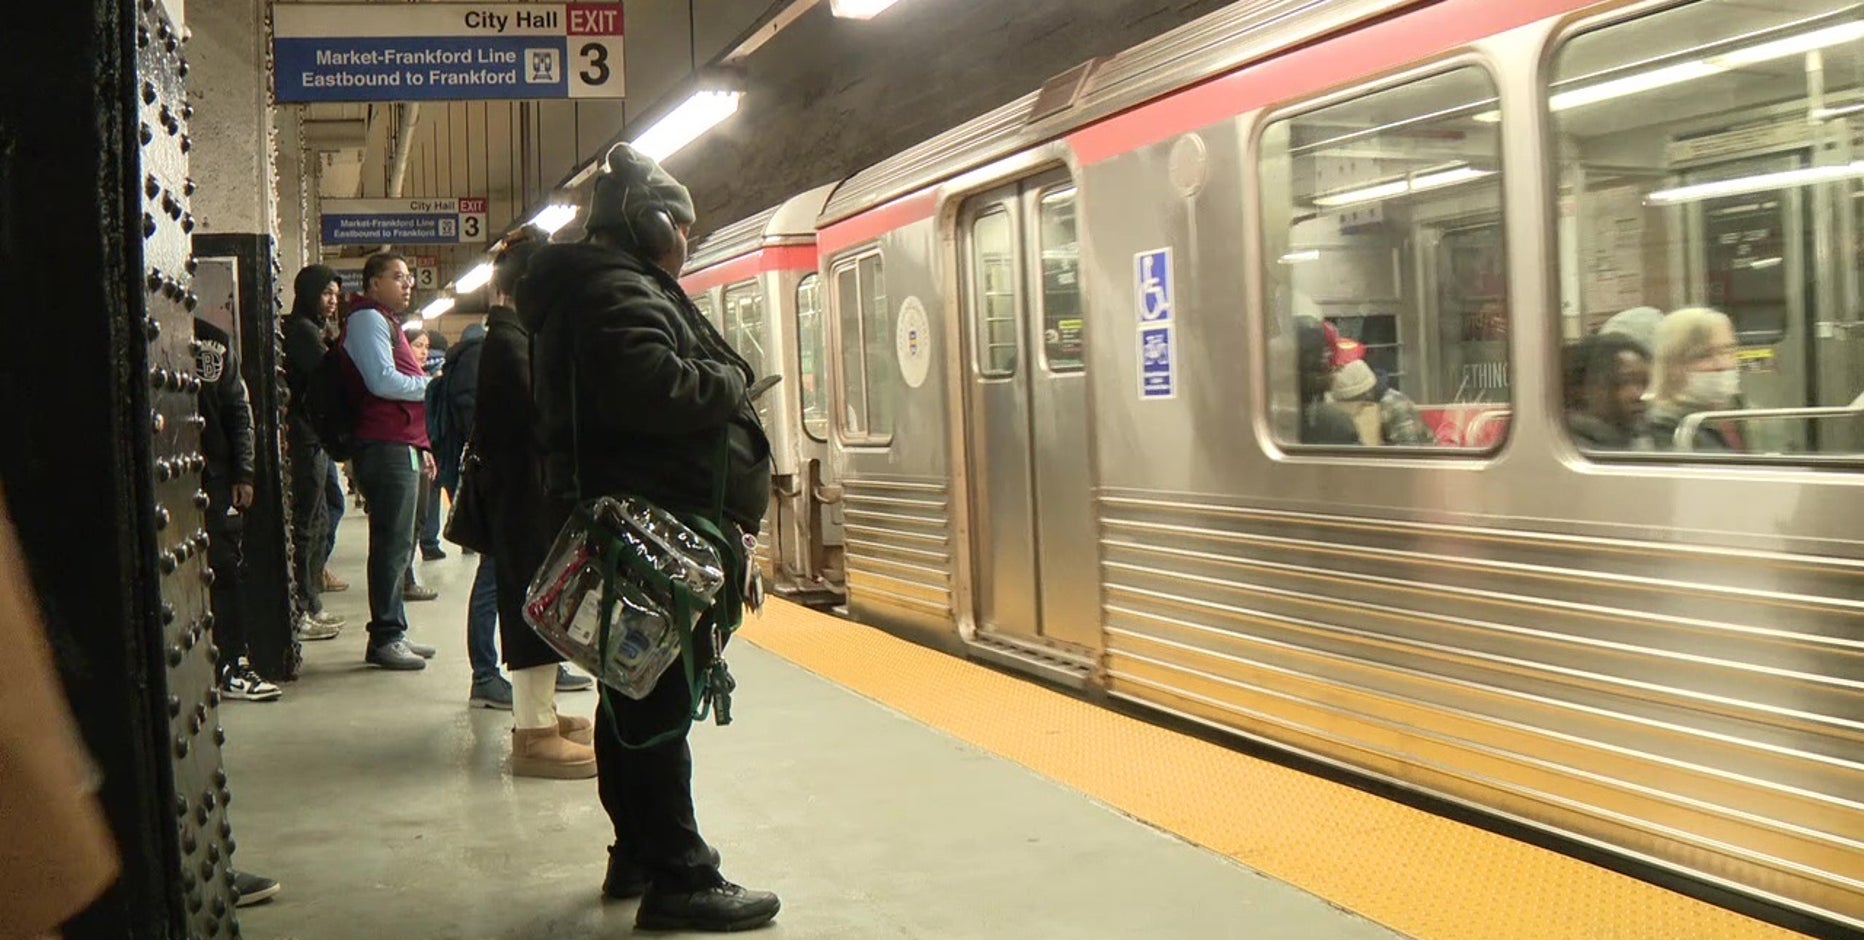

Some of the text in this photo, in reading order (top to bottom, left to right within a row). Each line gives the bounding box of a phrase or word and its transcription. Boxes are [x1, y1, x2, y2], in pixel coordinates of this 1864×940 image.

[464, 11, 558, 32] City Hall
[570, 10, 618, 32] EXIT
[316, 49, 517, 66] Market-Frankford Line
[579, 43, 611, 86] 3
[302, 69, 517, 87] Eastbound to Frankford
[410, 200, 455, 211] City Hall
[460, 200, 484, 212] EXIT
[340, 219, 435, 228] Market-Frankford Line
[464, 216, 480, 238] 3
[333, 229, 435, 239] Eastbound to Frankford
[421, 269, 432, 285] 3
